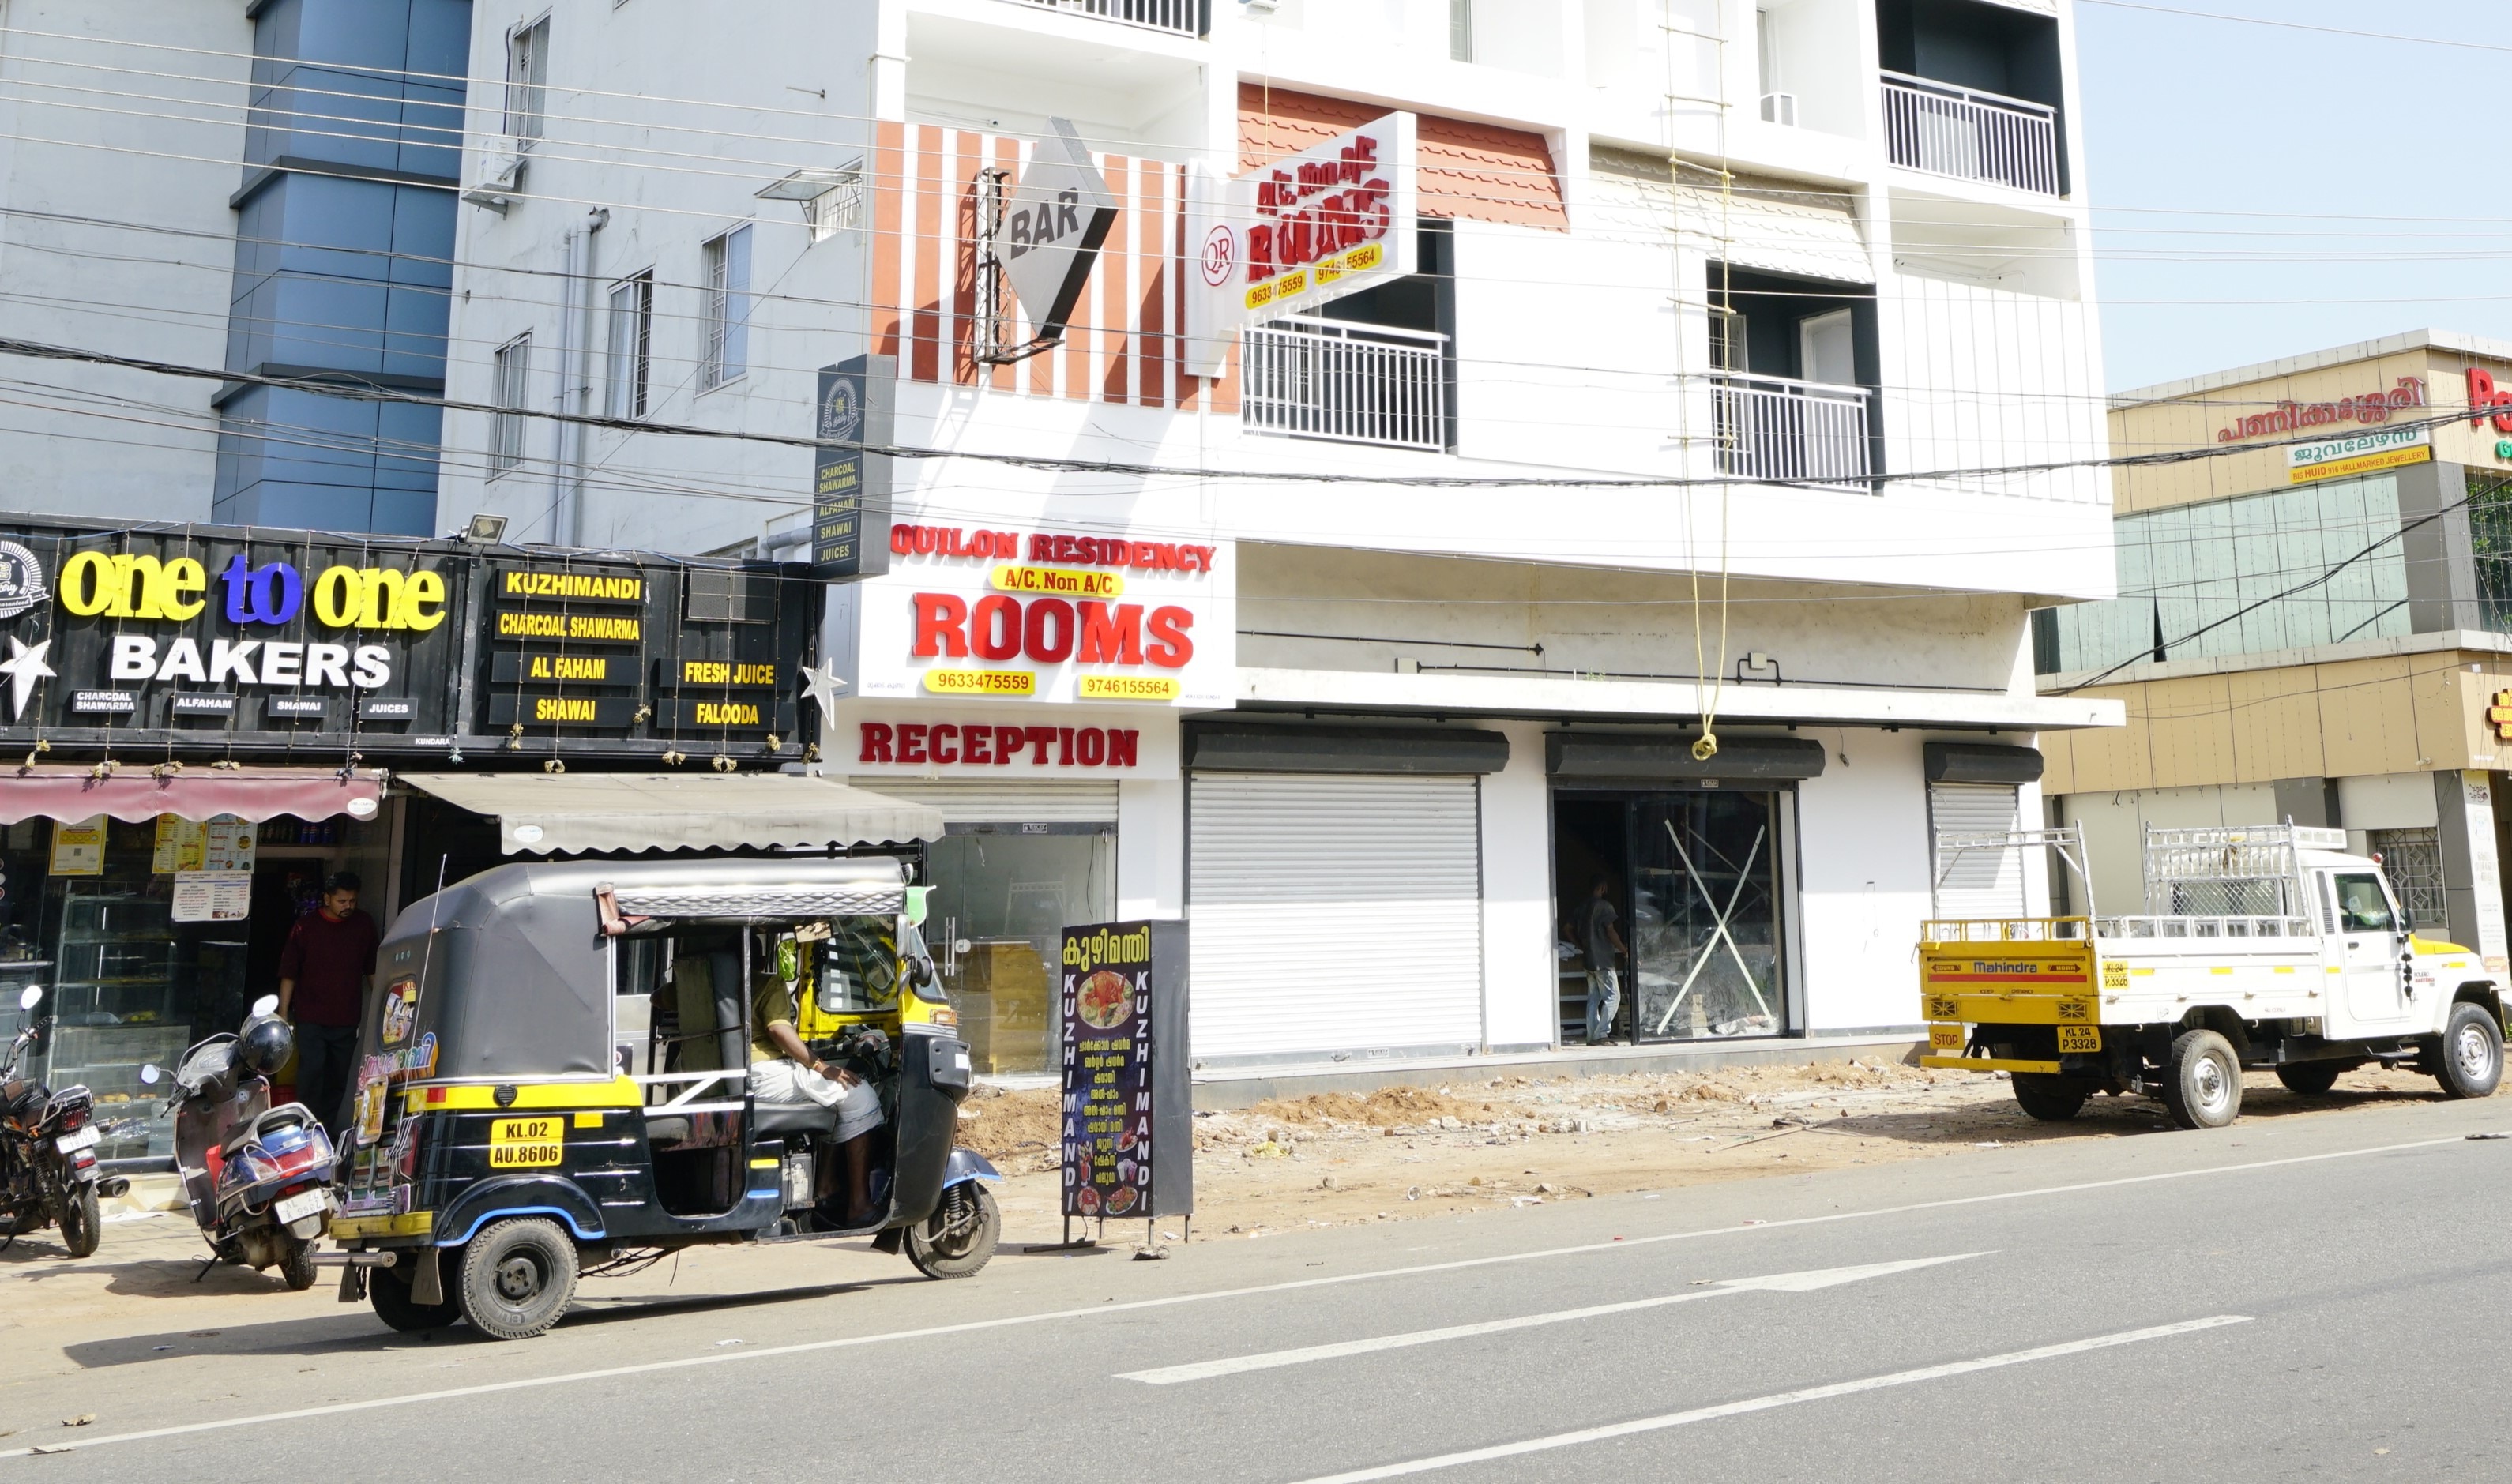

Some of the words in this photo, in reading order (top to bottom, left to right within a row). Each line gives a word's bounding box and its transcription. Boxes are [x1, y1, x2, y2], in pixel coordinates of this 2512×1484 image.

[1338, 135, 1377, 184] A/C
[1010, 186, 1079, 260] BAR
[1245, 178, 1390, 284] ROOMS
[1204, 237, 1230, 274] QR
[1252, 275, 1303, 305] 9633475559
[821, 462, 856, 479] CHARCOAL
[2292, 472, 2303, 481] BIS
[2304, 467, 2326, 479] HUID
[2328, 465, 2339, 474] 916
[2340, 458, 2384, 473] HALLMARKED
[2386, 450, 2426, 464] JEWELLERY
[819, 475, 856, 493] SHAWARMA
[819, 498, 855, 517] ALFAHAM
[821, 521, 852, 539] SHAWAI
[821, 544, 850, 562] JUICES
[890, 524, 1019, 559] QUILON
[1028, 533, 1217, 573] RESIDENCY
[60, 550, 206, 622] one
[220, 554, 303, 625] to
[314, 565, 446, 631] one
[506, 571, 641, 600] KUZHIMANDI
[1005, 568, 1040, 590] A/C,
[1044, 571, 1077, 591] Non
[1084, 573, 1112, 593] A/C
[500, 613, 566, 637] CHARCOAL
[570, 615, 640, 641] SHAWARMA
[912, 592, 1194, 668] ROOMS
[111, 635, 390, 688] BAKERS
[531, 657, 552, 678] AL
[555, 658, 606, 679] FAHAM
[685, 662, 730, 683] FRESH
[734, 664, 774, 685] JUICE
[938, 674, 1029, 689] 9633475559
[77, 692, 131, 701] CHARCOAL
[1087, 679, 1169, 694] 9746155564
[76, 701, 135, 711] SHAWARMA
[177, 697, 232, 708] ALFAHAM
[277, 701, 321, 711] SHAWAI
[369, 704, 408, 713] JUICES
[536, 699, 596, 721] SHAWAI
[696, 703, 759, 725] FALOODA
[859, 722, 1139, 768] RECEPTION
[1062, 926, 1149, 972] കുഴിമന്തി
[1974, 962, 2037, 974] Mahindra
[1935, 1033, 1958, 1046] STOP
[2066, 1028, 2091, 1037] KL.24
[2063, 1038, 2097, 1050] P.3328
[1063, 974, 1077, 1212] KUZHIMANDI
[1135, 971, 1150, 1211] KUZHIMANDI
[506, 1122, 547, 1138] KL.02
[494, 1145, 558, 1163] AU.8606
